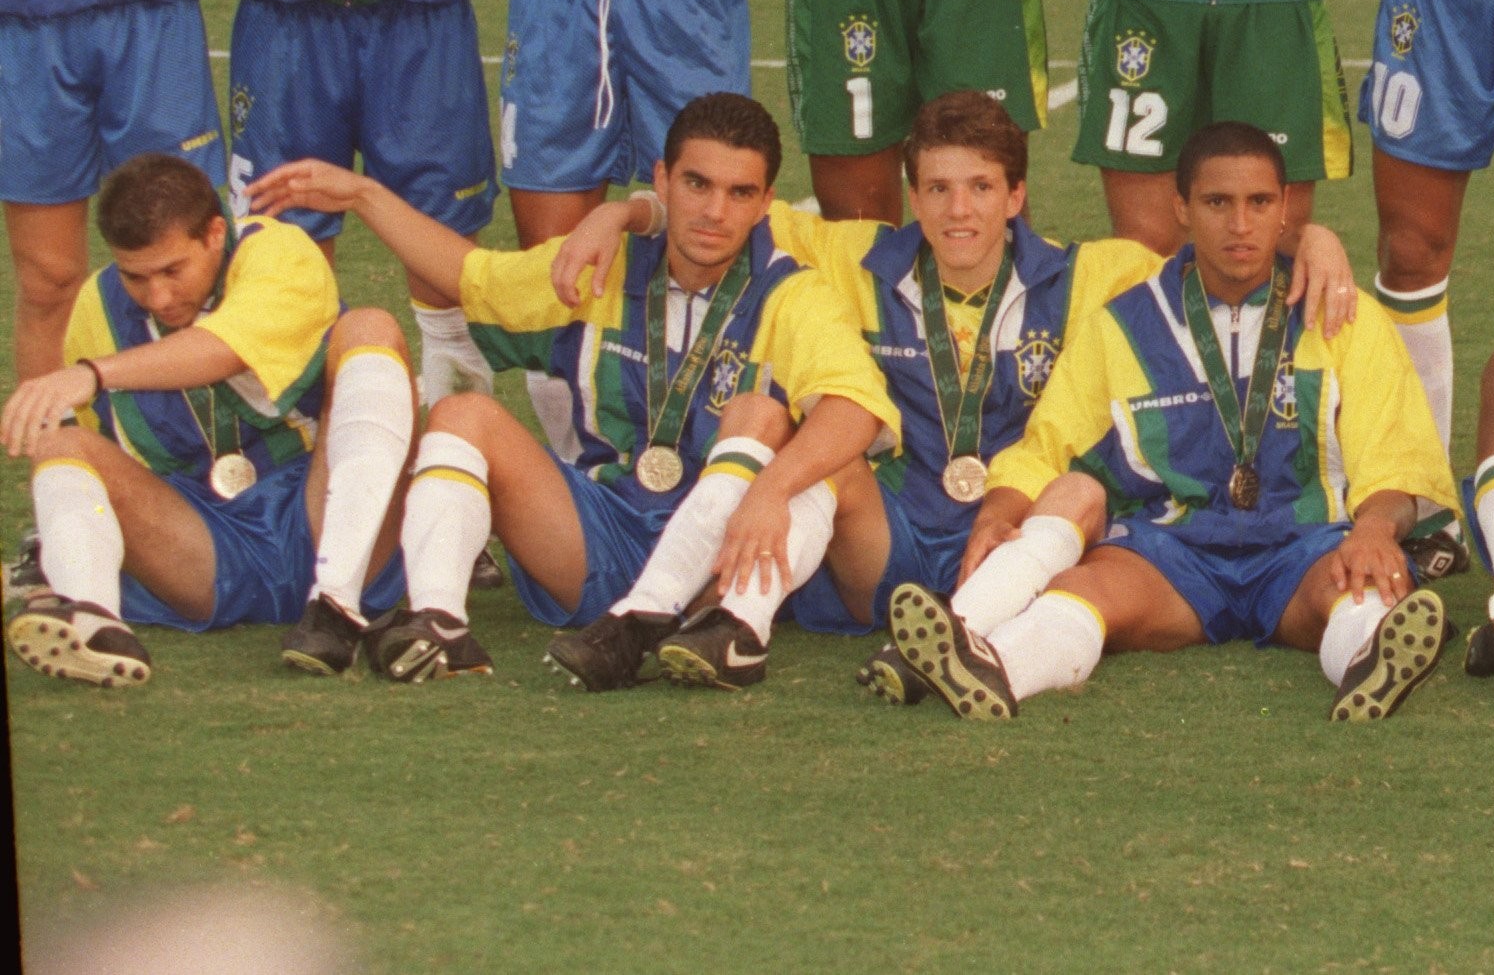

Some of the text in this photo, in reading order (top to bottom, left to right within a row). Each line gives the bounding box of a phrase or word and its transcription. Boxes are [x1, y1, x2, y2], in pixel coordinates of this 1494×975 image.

[846, 78, 873, 139] 1
[1106, 88, 1168, 156] 12
[1131, 393, 1199, 412] UMBRO
